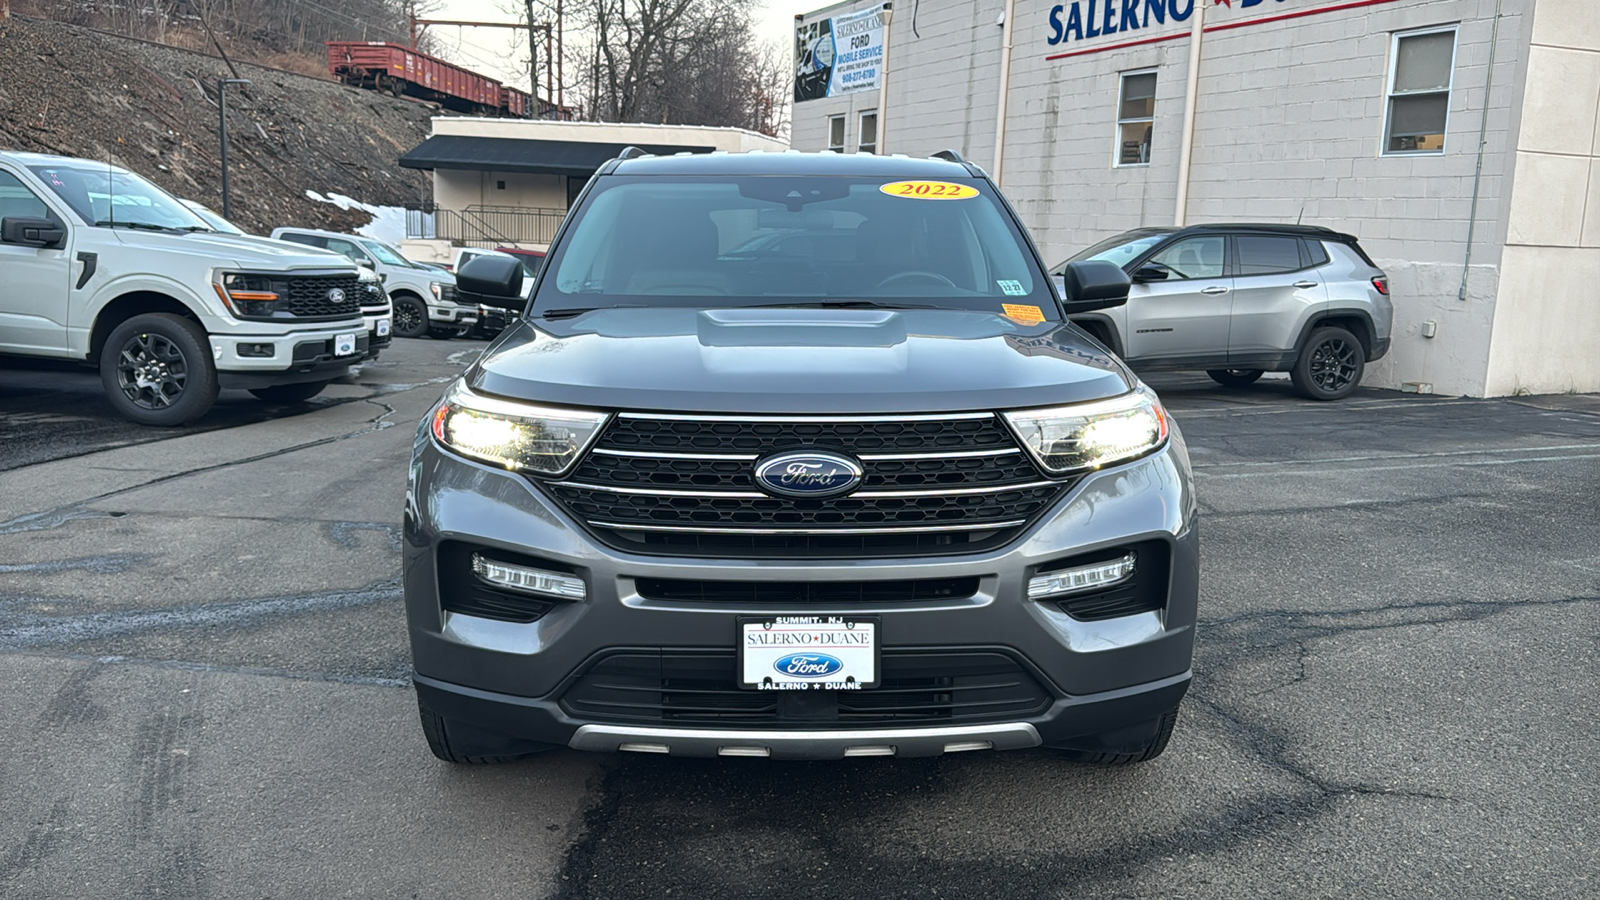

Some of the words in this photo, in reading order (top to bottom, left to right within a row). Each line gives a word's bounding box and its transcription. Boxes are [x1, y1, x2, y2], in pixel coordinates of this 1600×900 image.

[851, 34, 870, 50] FORD
[838, 51, 858, 65] MOBILE
[858, 45, 882, 60] SERVICE
[898, 184, 962, 196] 2022
[781, 462, 837, 486] Ford
[828, 616, 844, 625] NJ
[747, 632, 813, 645] SALERNO
[819, 632, 870, 645] DUANE
[786, 656, 831, 674] Ford
[757, 682, 809, 691] SALERNO
[824, 682, 862, 691] DUANE
